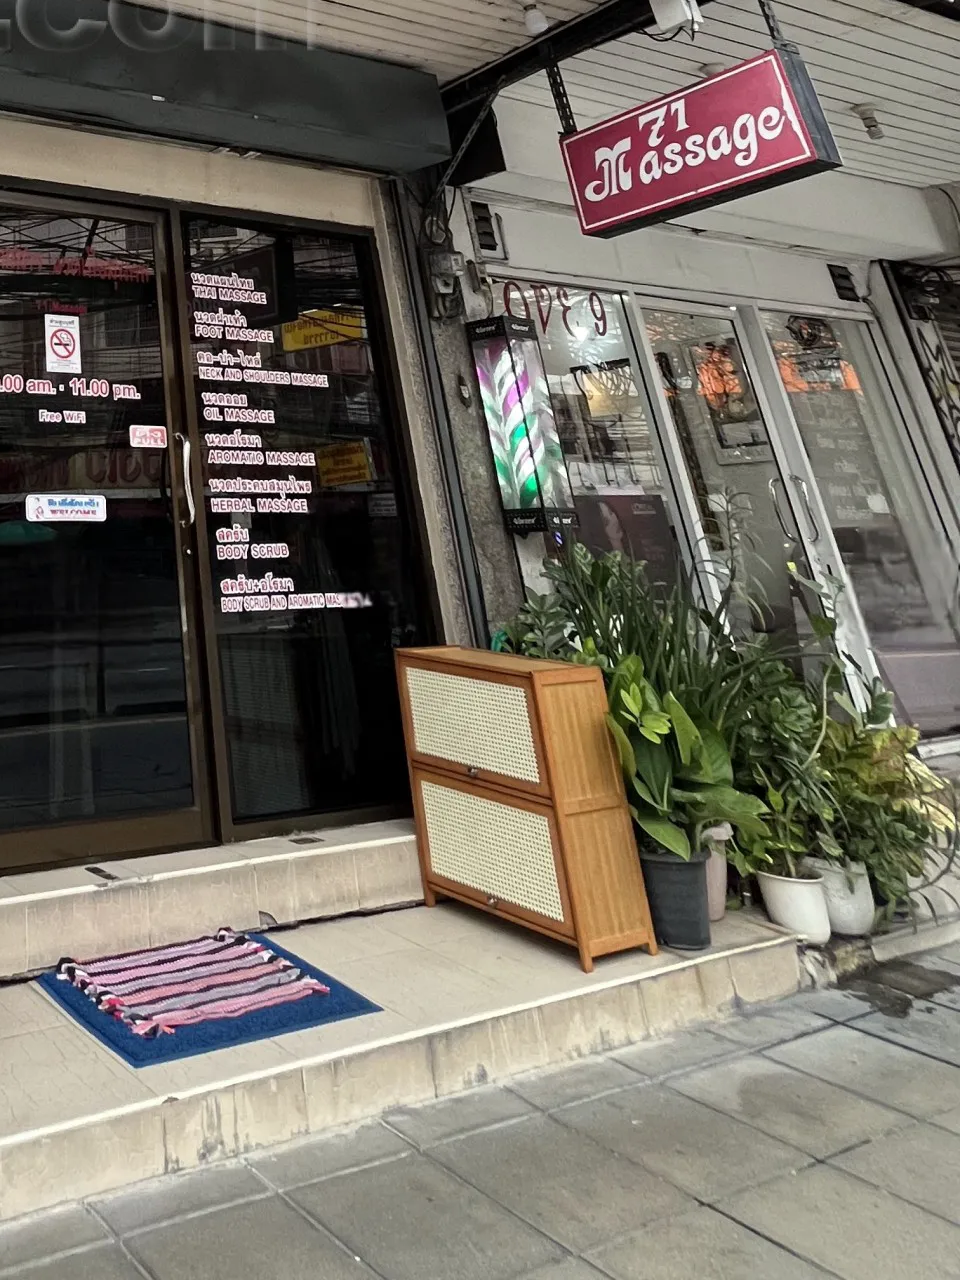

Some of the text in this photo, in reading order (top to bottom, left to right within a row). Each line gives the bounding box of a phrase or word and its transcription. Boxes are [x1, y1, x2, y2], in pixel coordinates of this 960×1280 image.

[638, 98, 689, 147] 71
[584, 105, 786, 202] Massage
[191, 271, 254, 290] นวดแผนไทย
[192, 285, 267, 304] THAI MASSAGE
[193, 307, 247, 327] นวดฝ่าเท้า
[194, 324, 224, 339] FOOT
[225, 326, 274, 343] MASSAGE
[197, 349, 262, 368] คอ-บ่า-ไหล่
[198, 366, 329, 388] NECK AND SHOULDERS MASSAGE
[25, 379, 57, 395] am.
[69, 378, 109, 397] 11.00
[112, 383, 141, 401] pm.
[38, 410, 86, 424] Free WiFi
[203, 407, 276, 424] OIL MASSAGE
[205, 428, 262, 448] นวดอโรมา
[208, 450, 316, 466] AROMATIC MASSAGE
[209, 474, 312, 499] นวดประคบสมุนไพร
[211, 498, 308, 513] HERBAL MASSAGE
[216, 523, 250, 543] สครับ
[216, 543, 290, 560] BODY SCRUB
[221, 596, 243, 613] BODY
[243, 595, 270, 611] SCRUB
[270, 594, 287, 610] AND
[287, 593, 325, 609] AROMATIC
